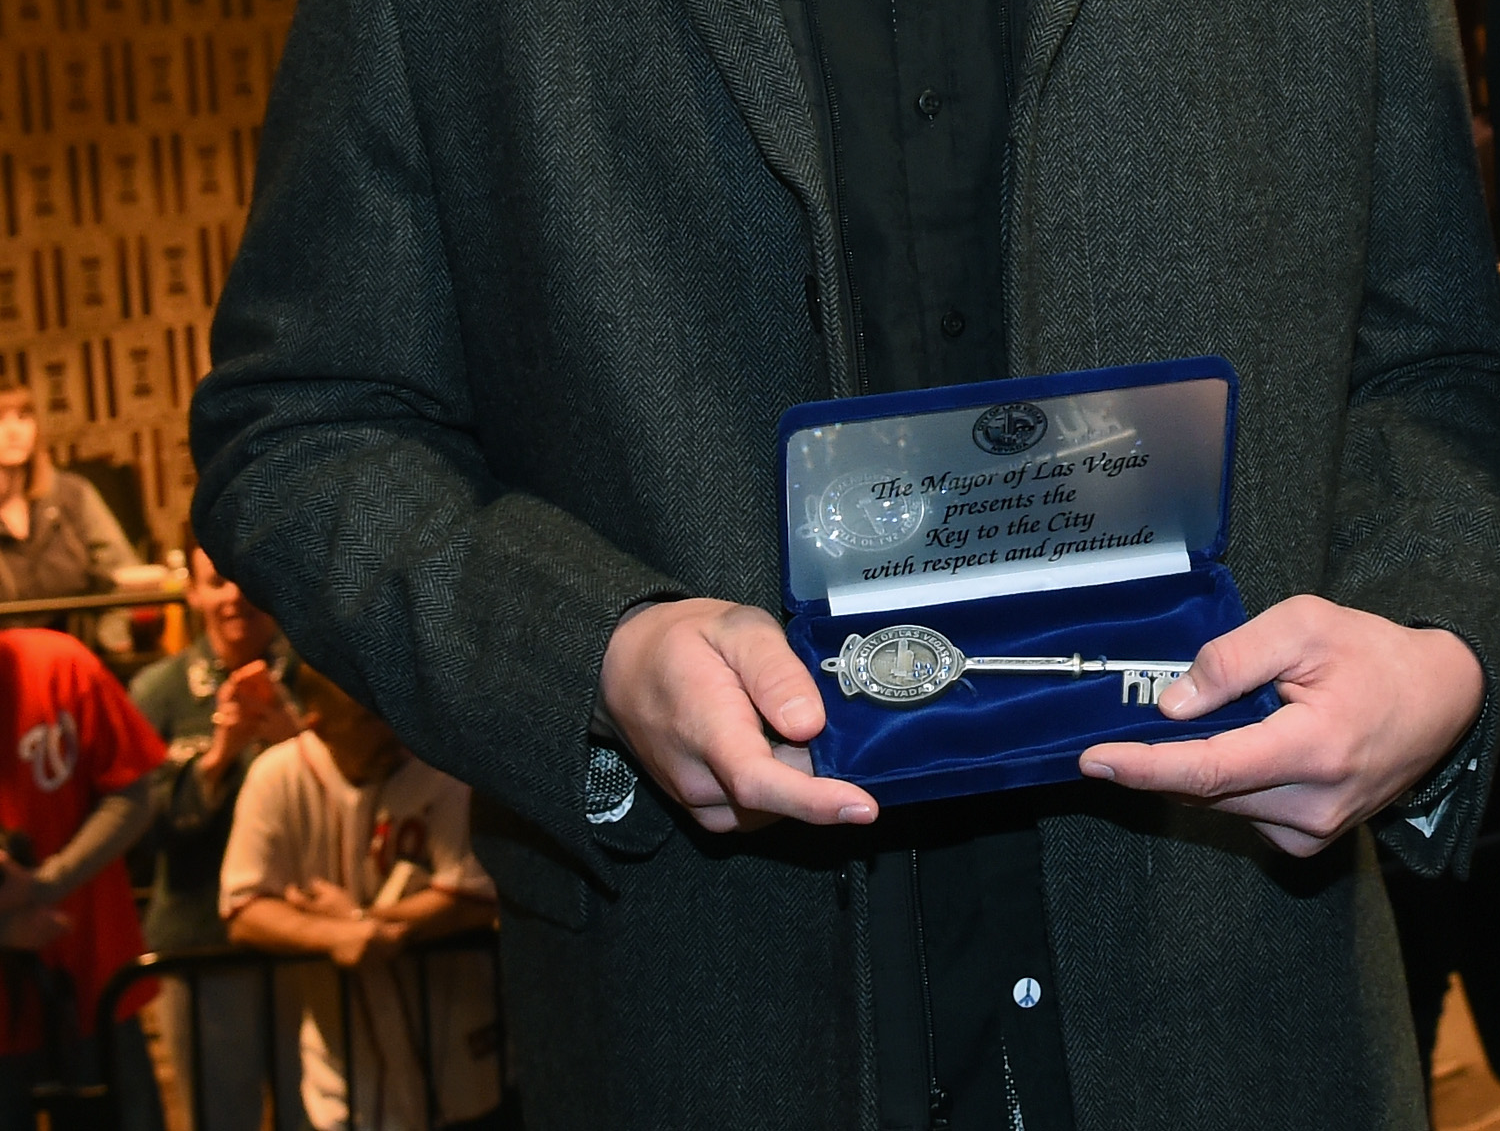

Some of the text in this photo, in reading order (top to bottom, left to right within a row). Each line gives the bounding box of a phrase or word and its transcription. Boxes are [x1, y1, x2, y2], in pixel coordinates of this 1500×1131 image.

[872, 452, 1150, 501] The Mayor of Las Vegas
[943, 486, 1077, 523] presents the
[925, 526, 969, 549] Key
[978, 524, 997, 540] to
[1007, 517, 1040, 536] the
[1048, 510, 1096, 533] City
[862, 525, 1155, 582] with respect and gratitude
[860, 630, 950, 658] CITY OF LAS VEGAS
